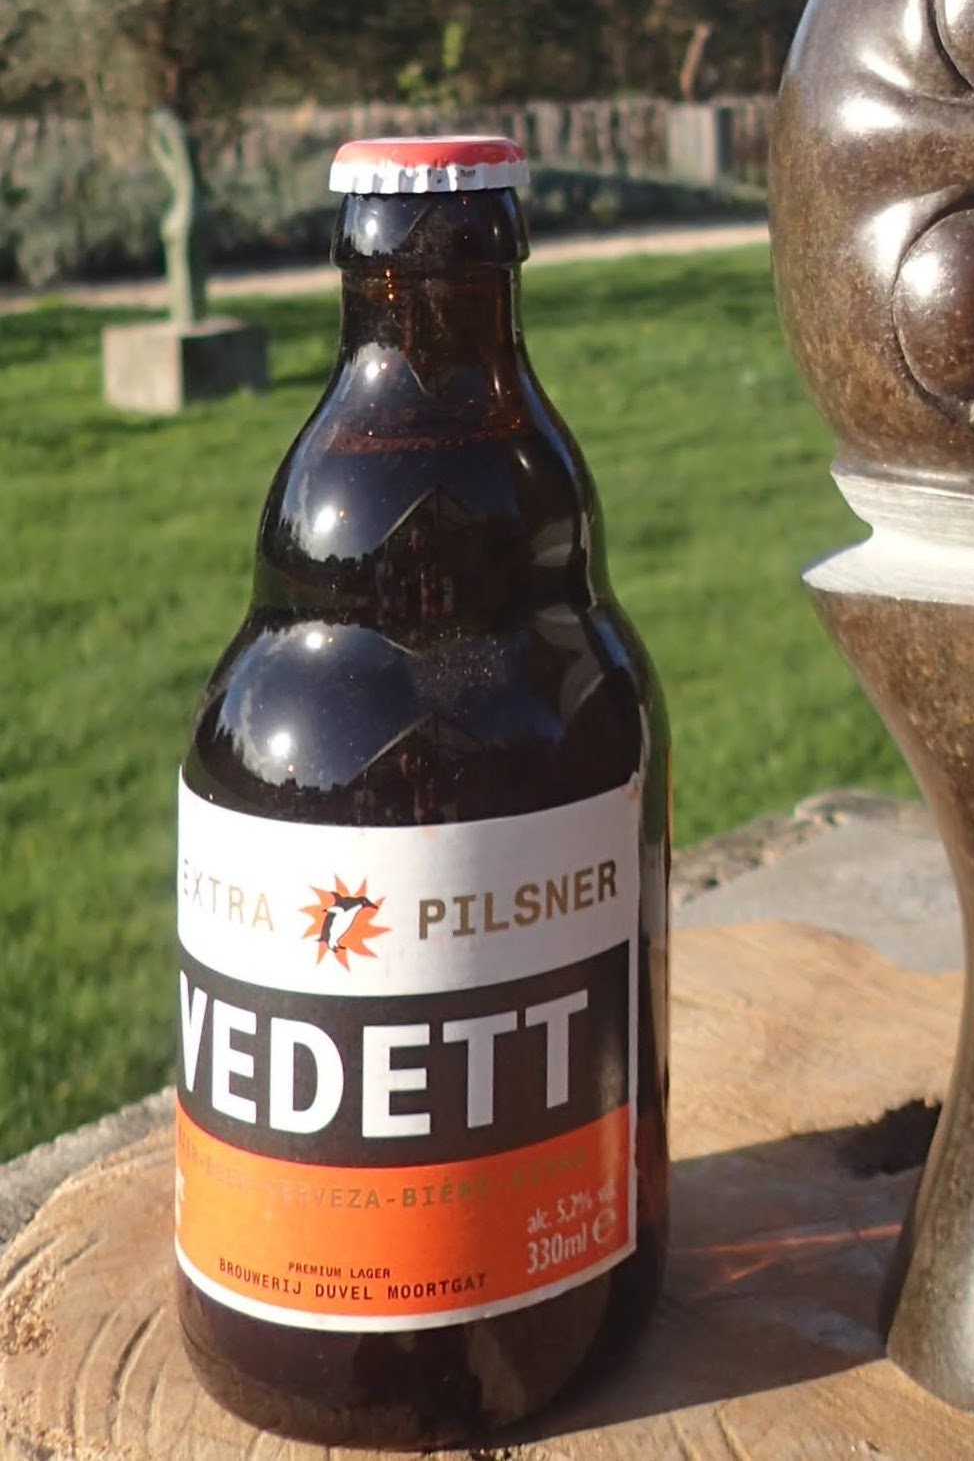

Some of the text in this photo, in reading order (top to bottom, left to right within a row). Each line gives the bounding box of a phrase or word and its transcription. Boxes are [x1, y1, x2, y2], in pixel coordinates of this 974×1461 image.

[183, 857, 618, 941] EXTRA PILSNER
[178, 969, 589, 1139] VEDETT
[288, 1261, 391, 1279] PREMIUM LAGER
[526, 1221, 588, 1275] 330ml
[219, 1257, 488, 1301] BROUWERIJ DUVEL MOORTGAT
